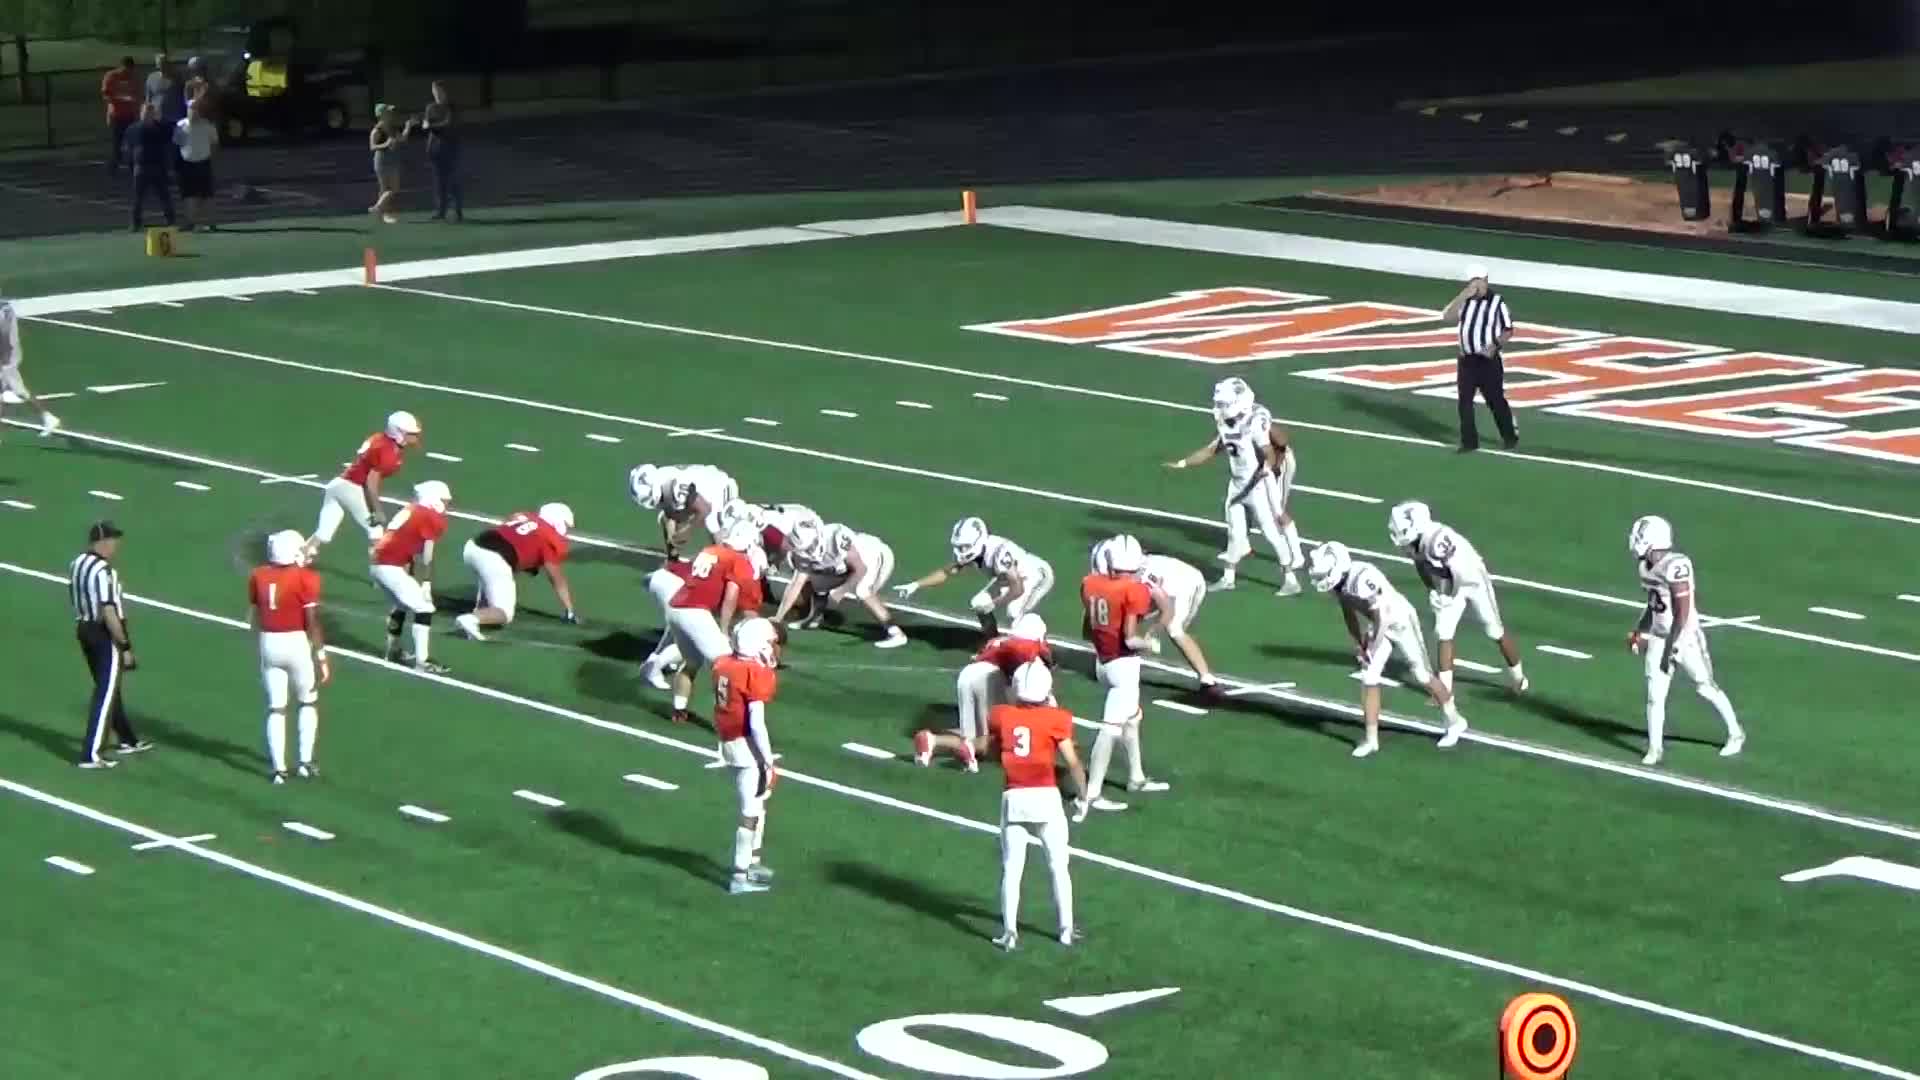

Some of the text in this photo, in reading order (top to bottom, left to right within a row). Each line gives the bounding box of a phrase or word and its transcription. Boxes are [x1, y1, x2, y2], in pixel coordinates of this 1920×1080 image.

[269, 582, 277, 610] 1
[1089, 595, 1110, 626] 18
[1012, 725, 1031, 757] 3
